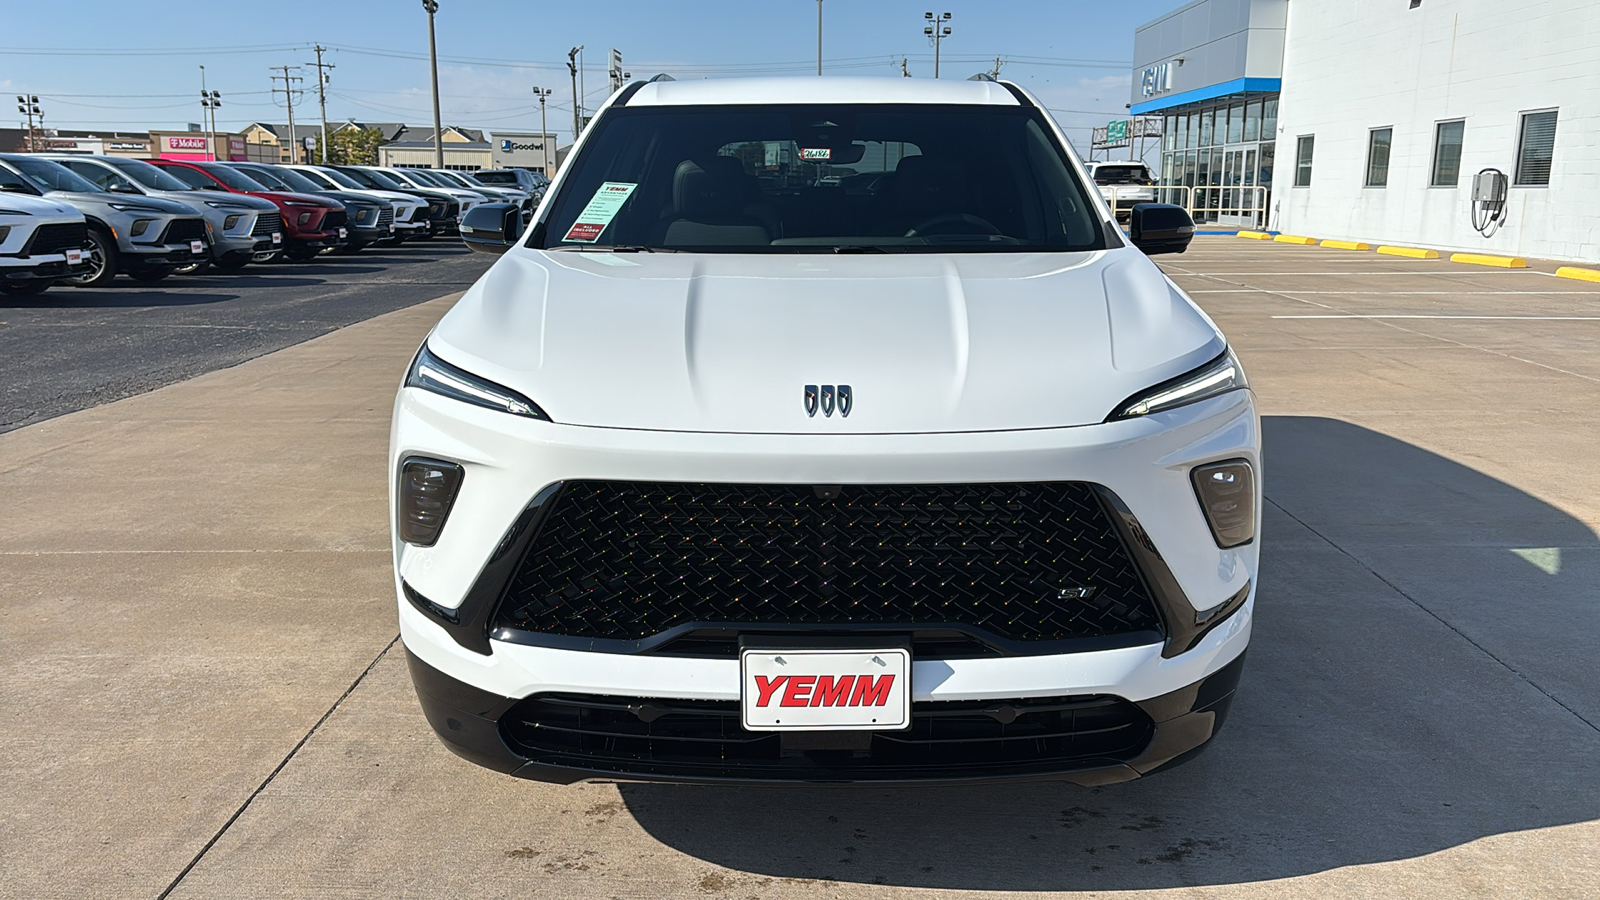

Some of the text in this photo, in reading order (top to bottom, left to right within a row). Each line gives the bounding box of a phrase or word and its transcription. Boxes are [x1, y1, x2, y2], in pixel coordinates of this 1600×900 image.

[178, 138, 204, 148] Mobile
[511, 143, 544, 151] Goodwi
[754, 674, 896, 708] YEMM
